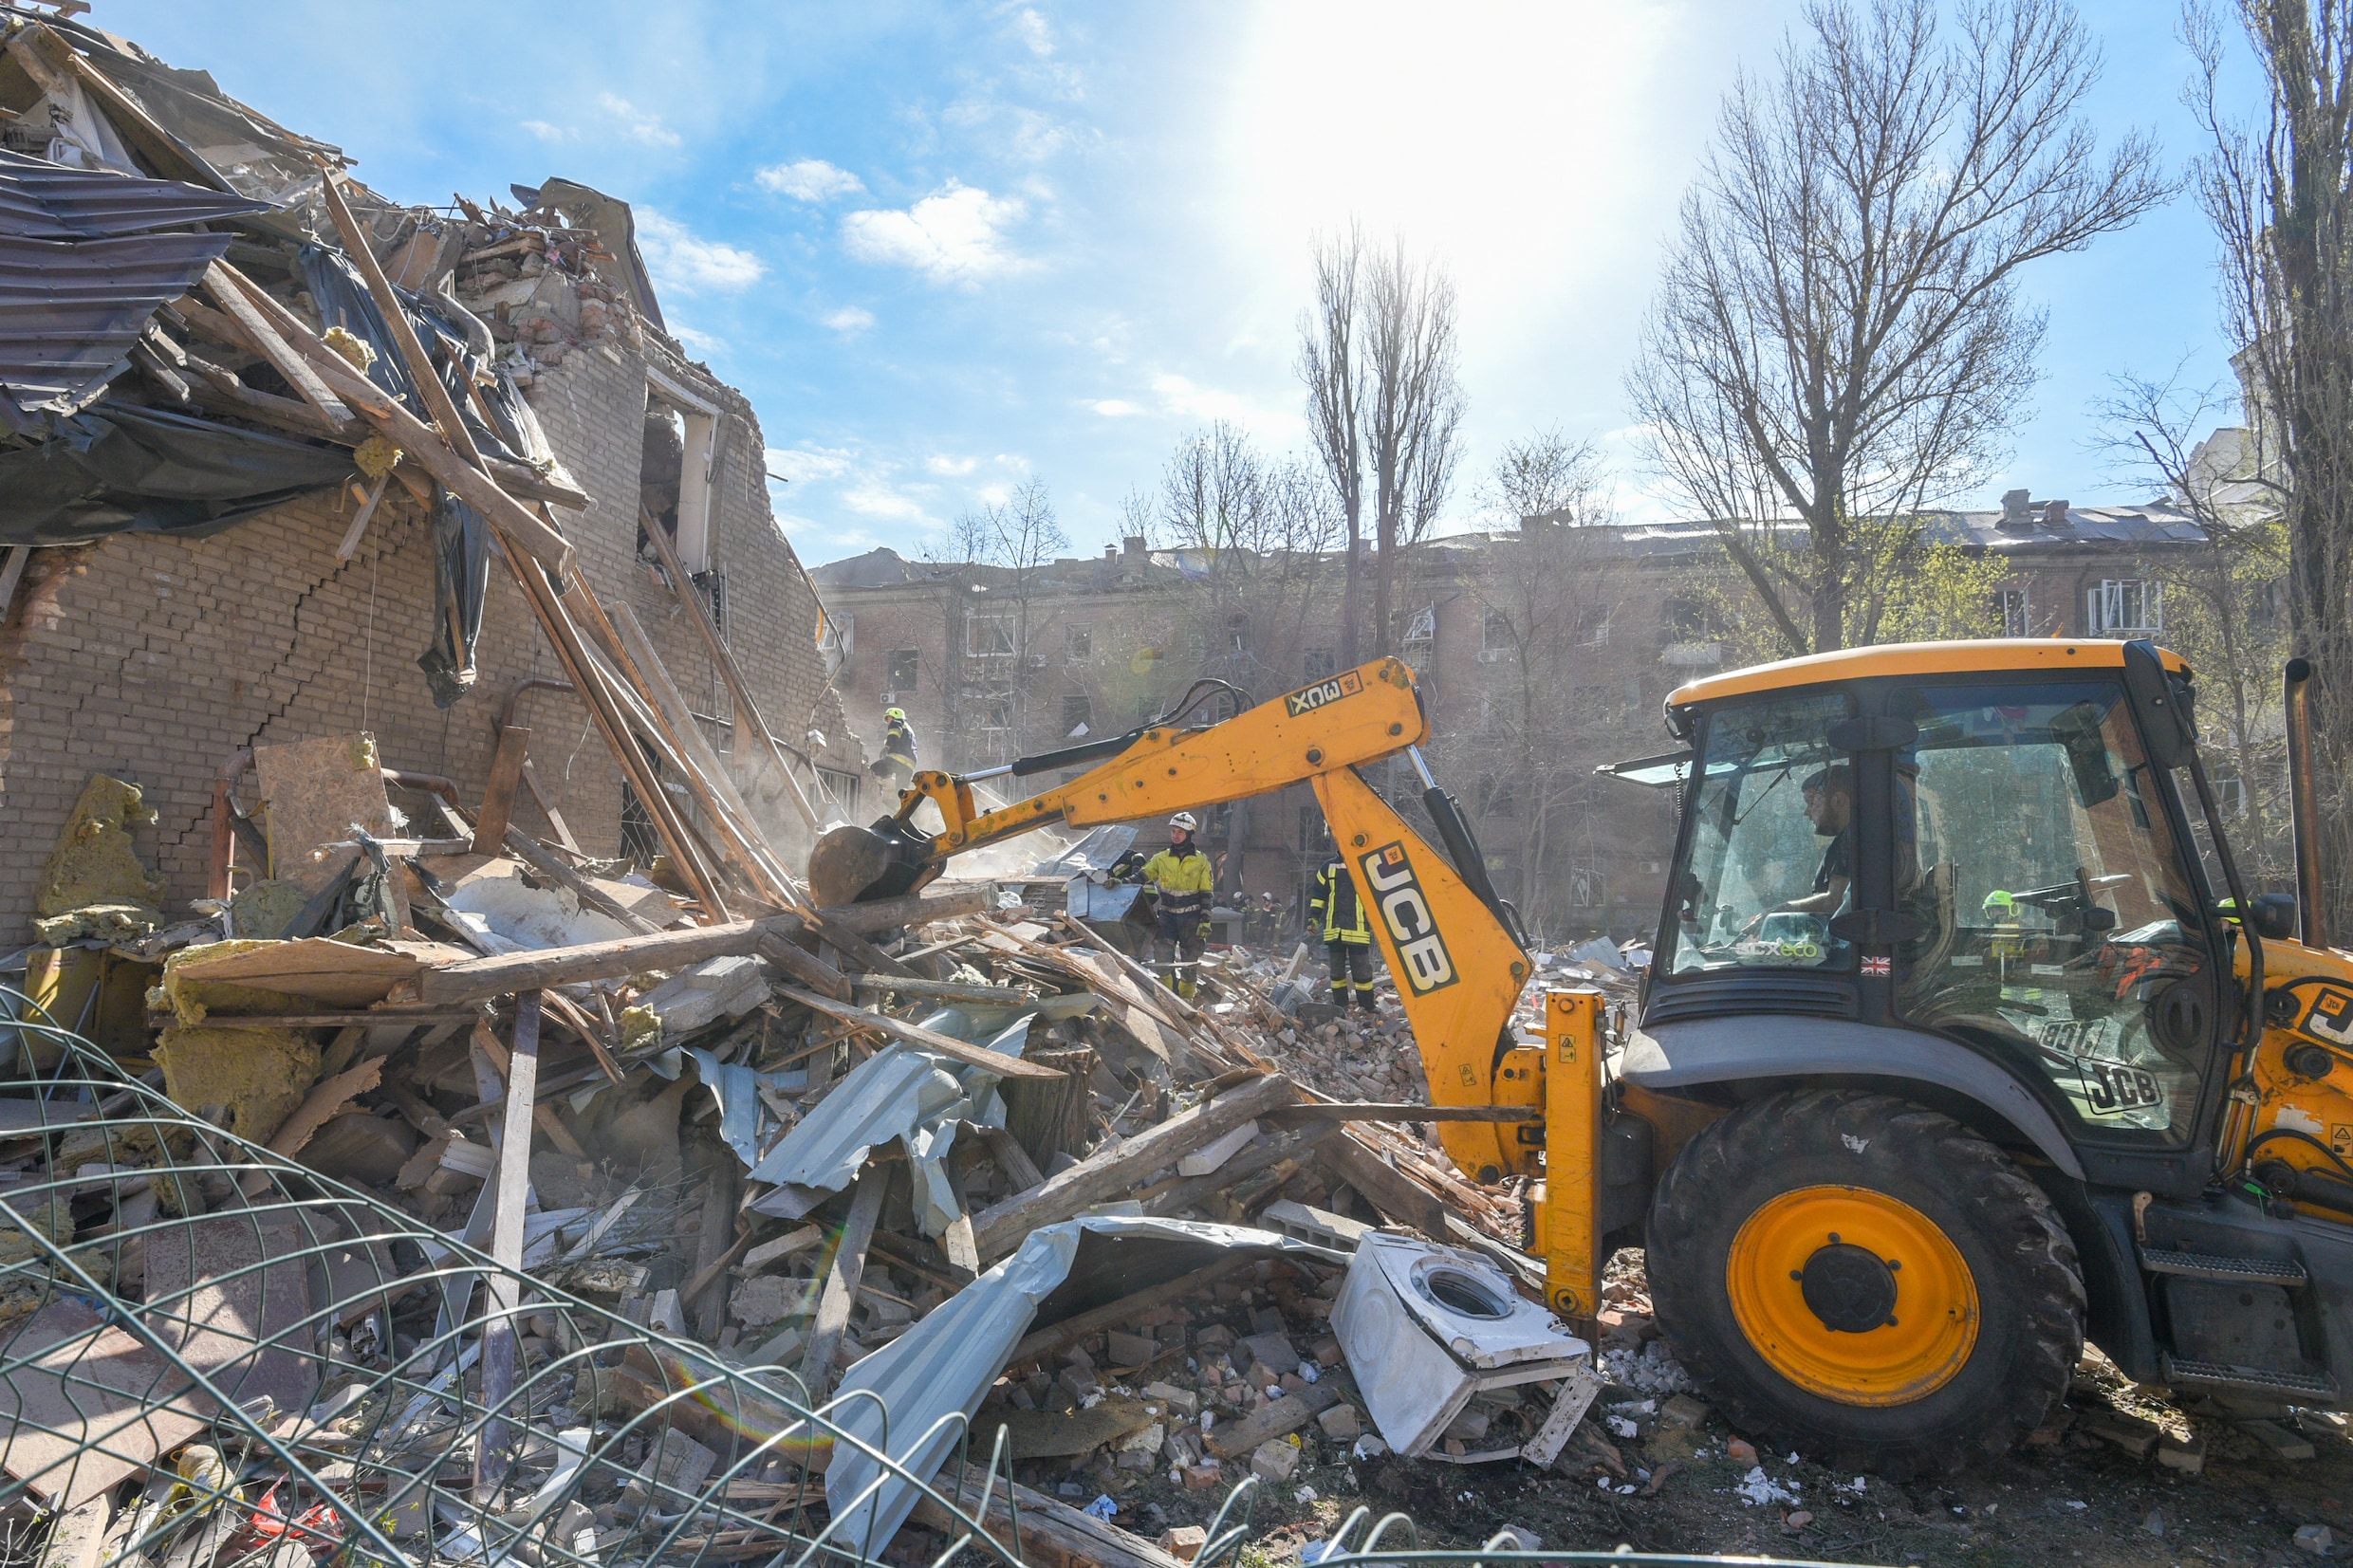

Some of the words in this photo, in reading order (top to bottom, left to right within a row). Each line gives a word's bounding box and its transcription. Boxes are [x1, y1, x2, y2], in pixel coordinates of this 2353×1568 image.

[1290, 681, 1341, 714] 3CX
[1365, 853, 1452, 990] JCB
[2091, 1063, 2157, 1108] JCB
